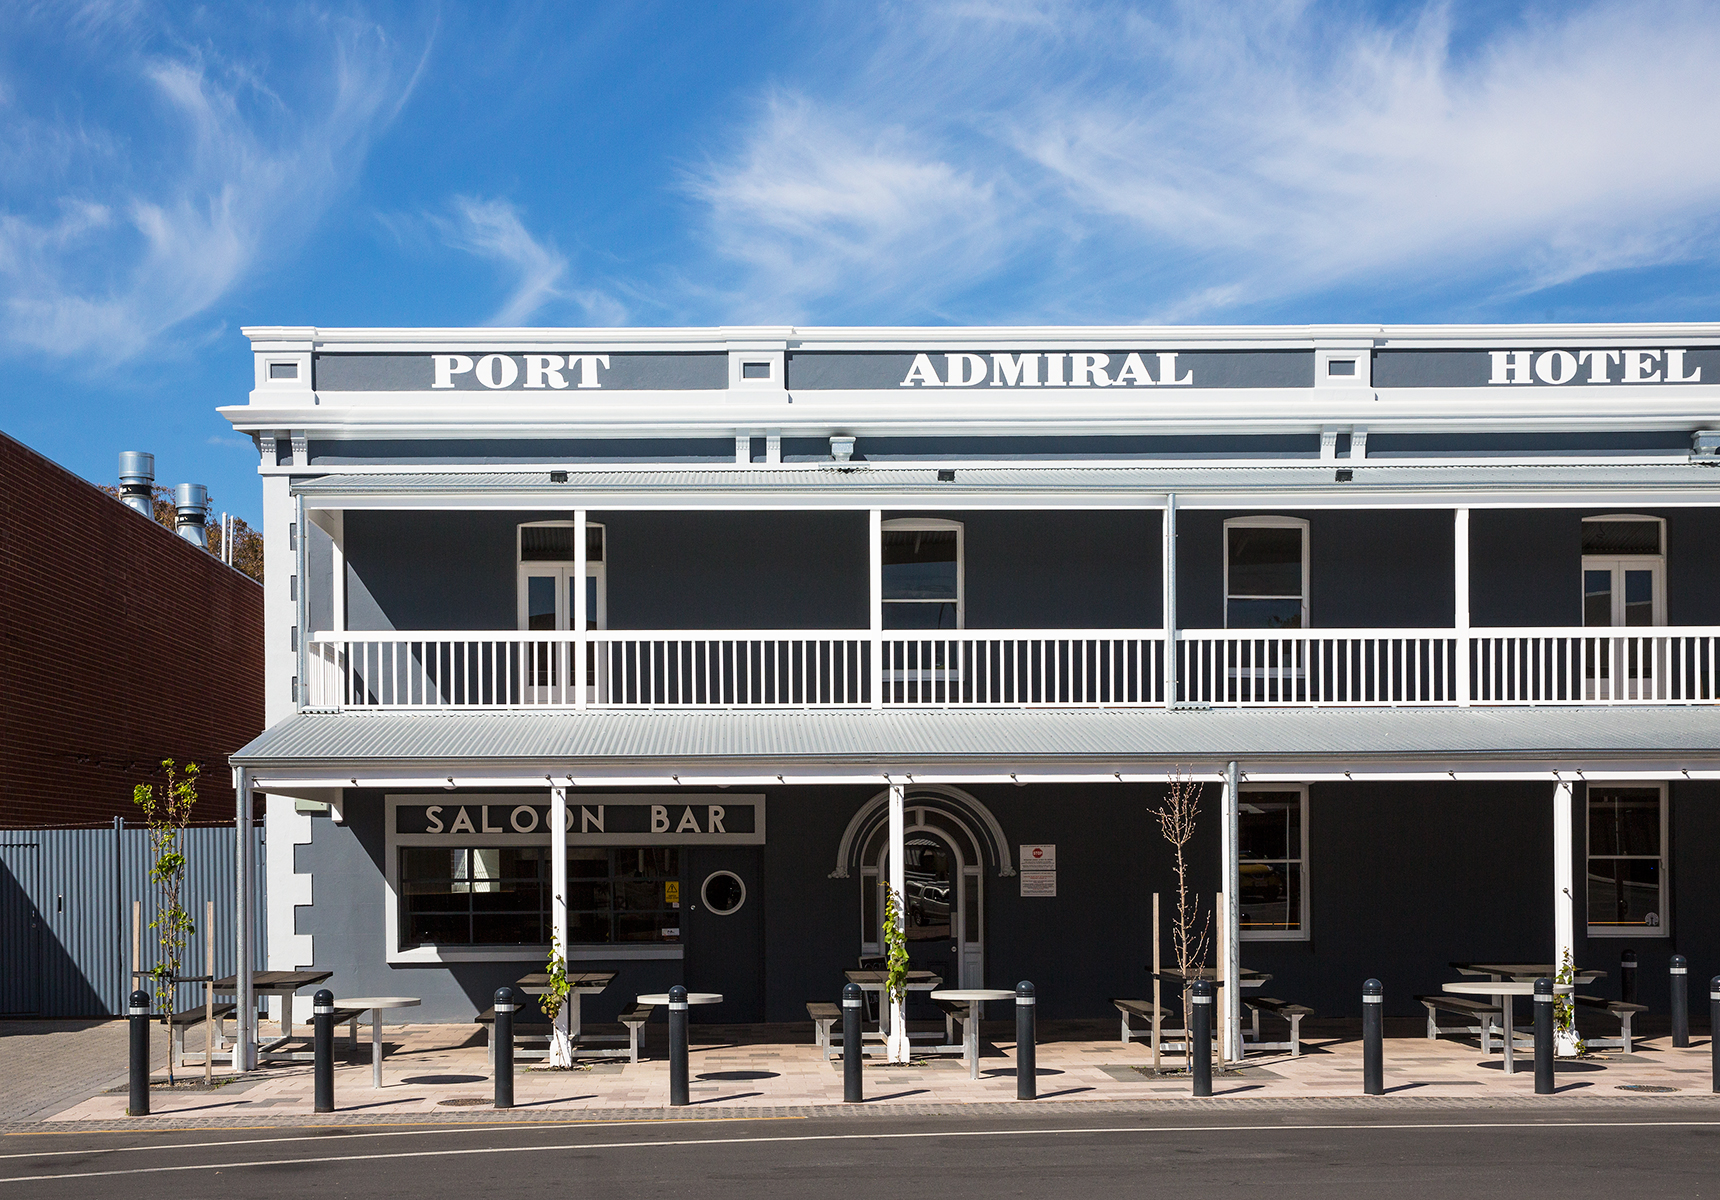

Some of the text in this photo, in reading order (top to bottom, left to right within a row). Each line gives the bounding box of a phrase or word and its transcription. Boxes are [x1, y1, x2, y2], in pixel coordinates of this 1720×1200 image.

[432, 349, 1702, 390] PORT ADMIRAL HOTEL
[425, 805, 726, 834] SALOON BAR
